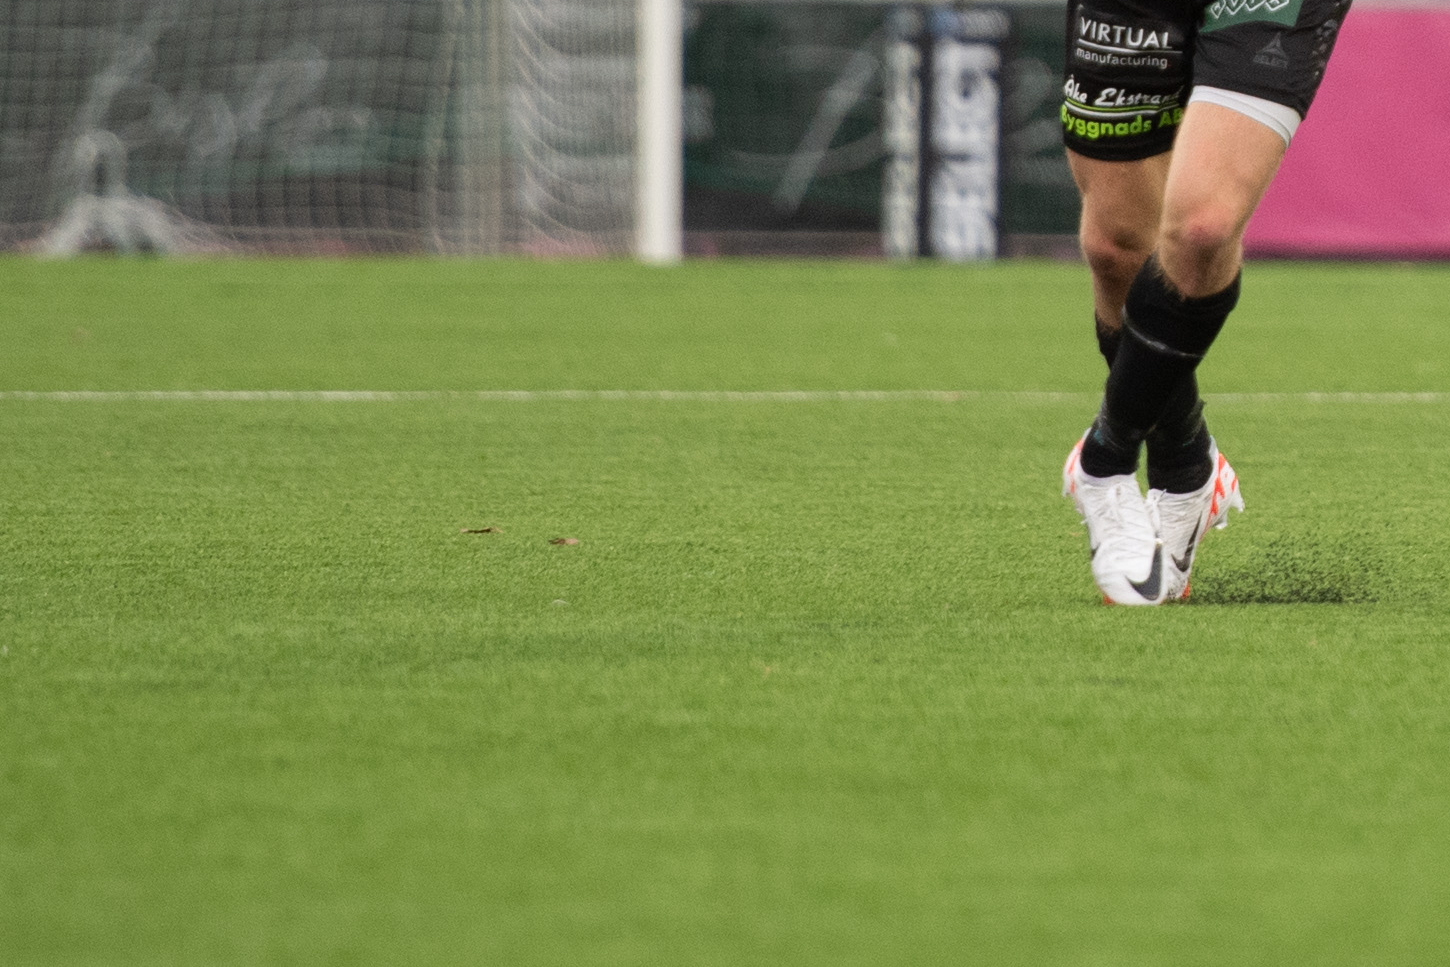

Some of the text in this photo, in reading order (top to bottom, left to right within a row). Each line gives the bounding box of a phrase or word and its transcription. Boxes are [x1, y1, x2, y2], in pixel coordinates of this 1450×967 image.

[1080, 16, 1173, 50] VIRTUAL
[1075, 47, 1168, 70] manufacturing
[1064, 74, 1088, 104] Åke
[1061, 104, 1152, 139] Byggnads
